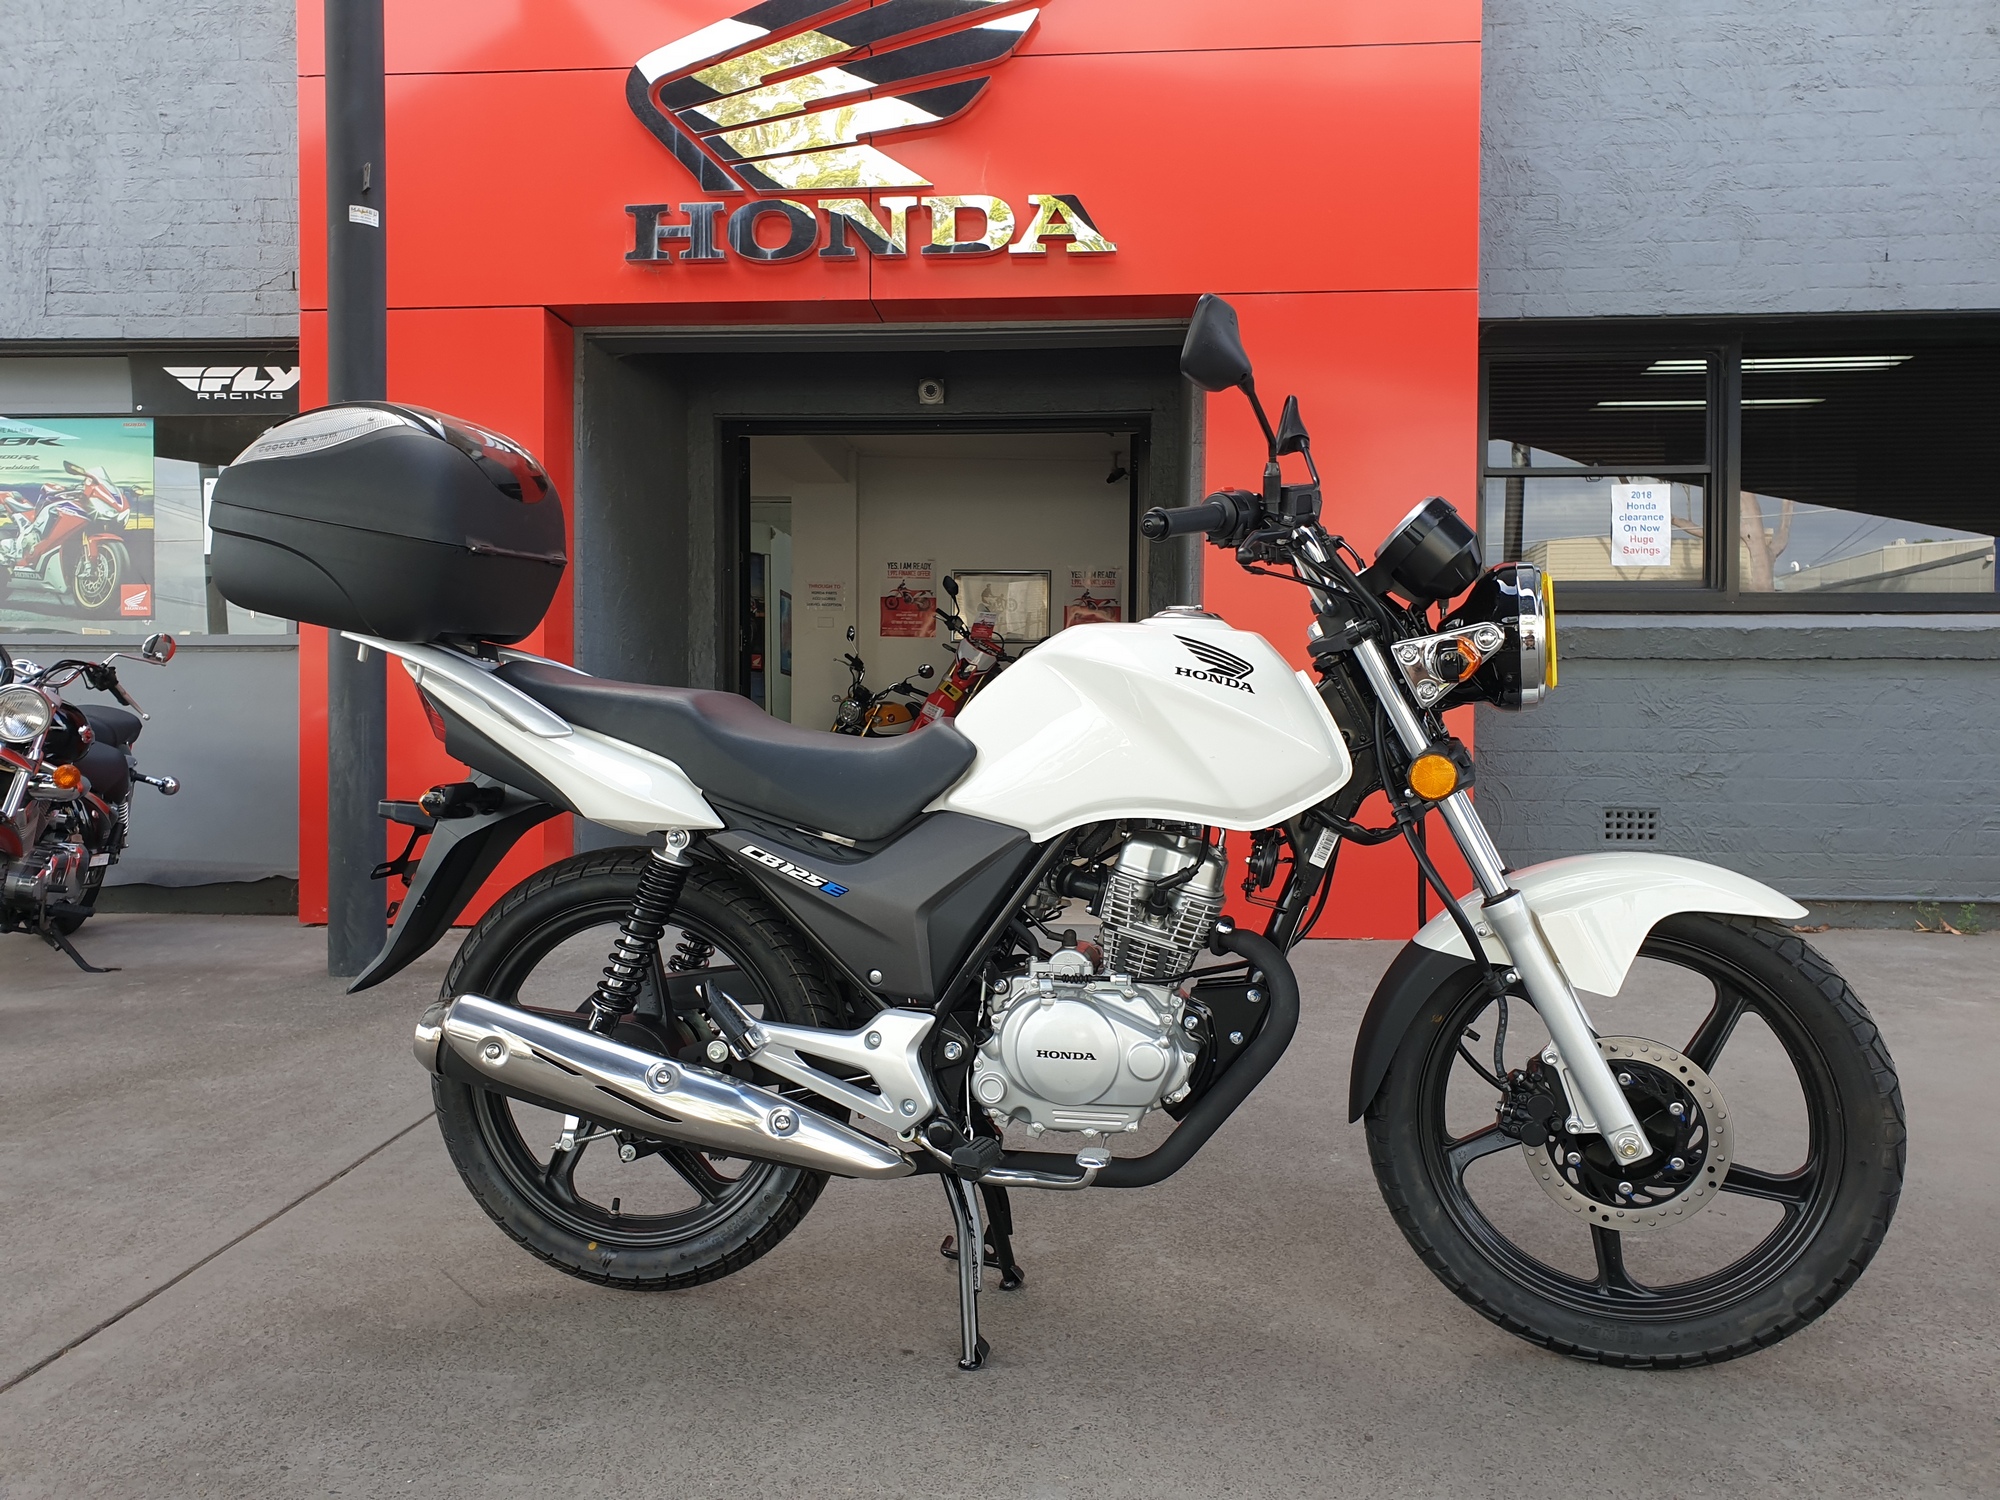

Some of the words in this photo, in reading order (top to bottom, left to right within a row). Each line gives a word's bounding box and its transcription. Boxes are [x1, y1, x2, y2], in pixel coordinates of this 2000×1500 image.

[624, 194, 1118, 263] HONDA
[163, 366, 300, 392] FLY
[196, 392, 284, 400] RACING
[1630, 491, 1652, 499] 2018
[1626, 502, 1657, 510] Honda
[1619, 513, 1664, 521] clearance
[1623, 524, 1637, 532] On
[1639, 524, 1660, 532] Now
[1629, 535, 1654, 545] Huge
[1622, 546, 1661, 556] Savings
[903, 562, 912, 570] AM
[1174, 666, 1256, 695] HONDA
[739, 845, 850, 897] CB125E
[1036, 1049, 1097, 1061] HONDA
